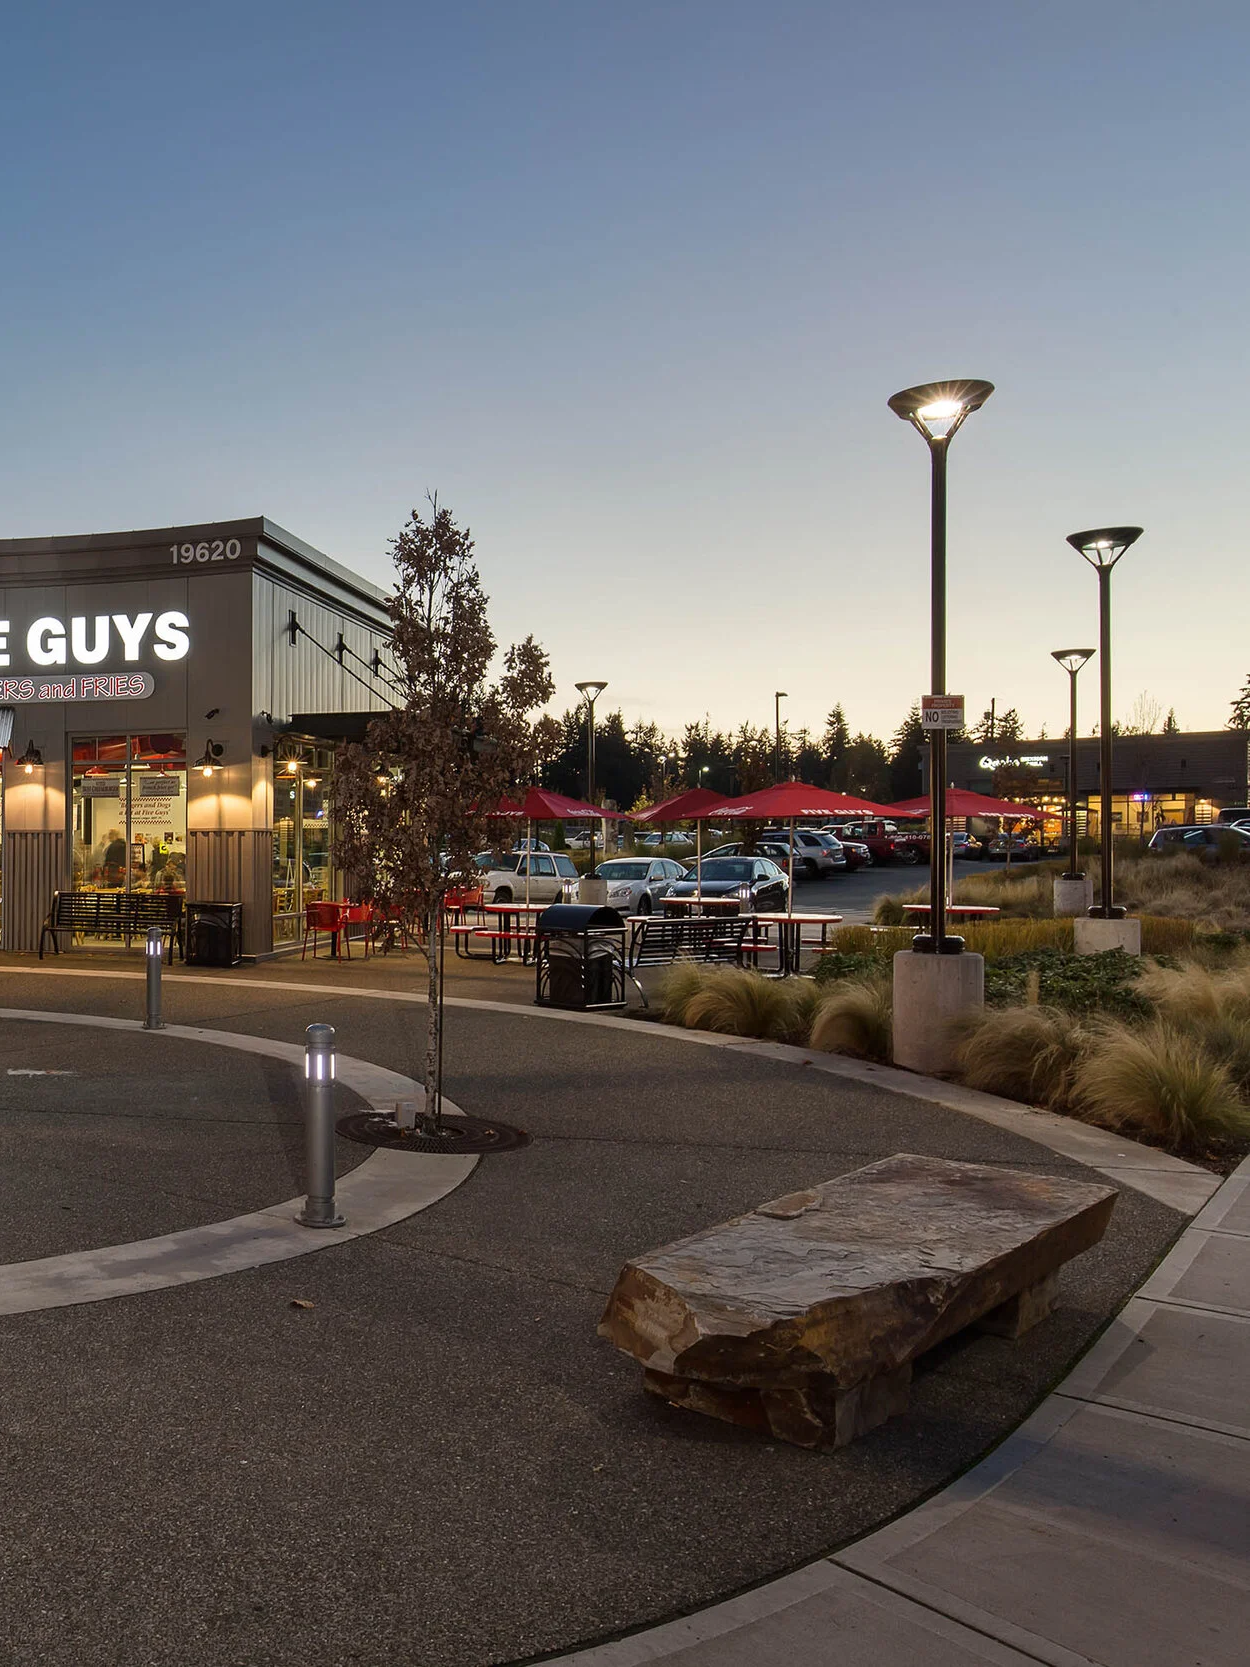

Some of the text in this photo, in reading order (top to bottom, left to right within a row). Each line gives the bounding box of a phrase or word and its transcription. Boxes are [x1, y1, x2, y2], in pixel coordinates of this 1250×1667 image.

[170, 539, 241, 564] 19620
[27, 611, 190, 666] GUYS
[39, 677, 76, 699] and
[81, 675, 145, 698] FRIES
[925, 711, 939, 722] NO
